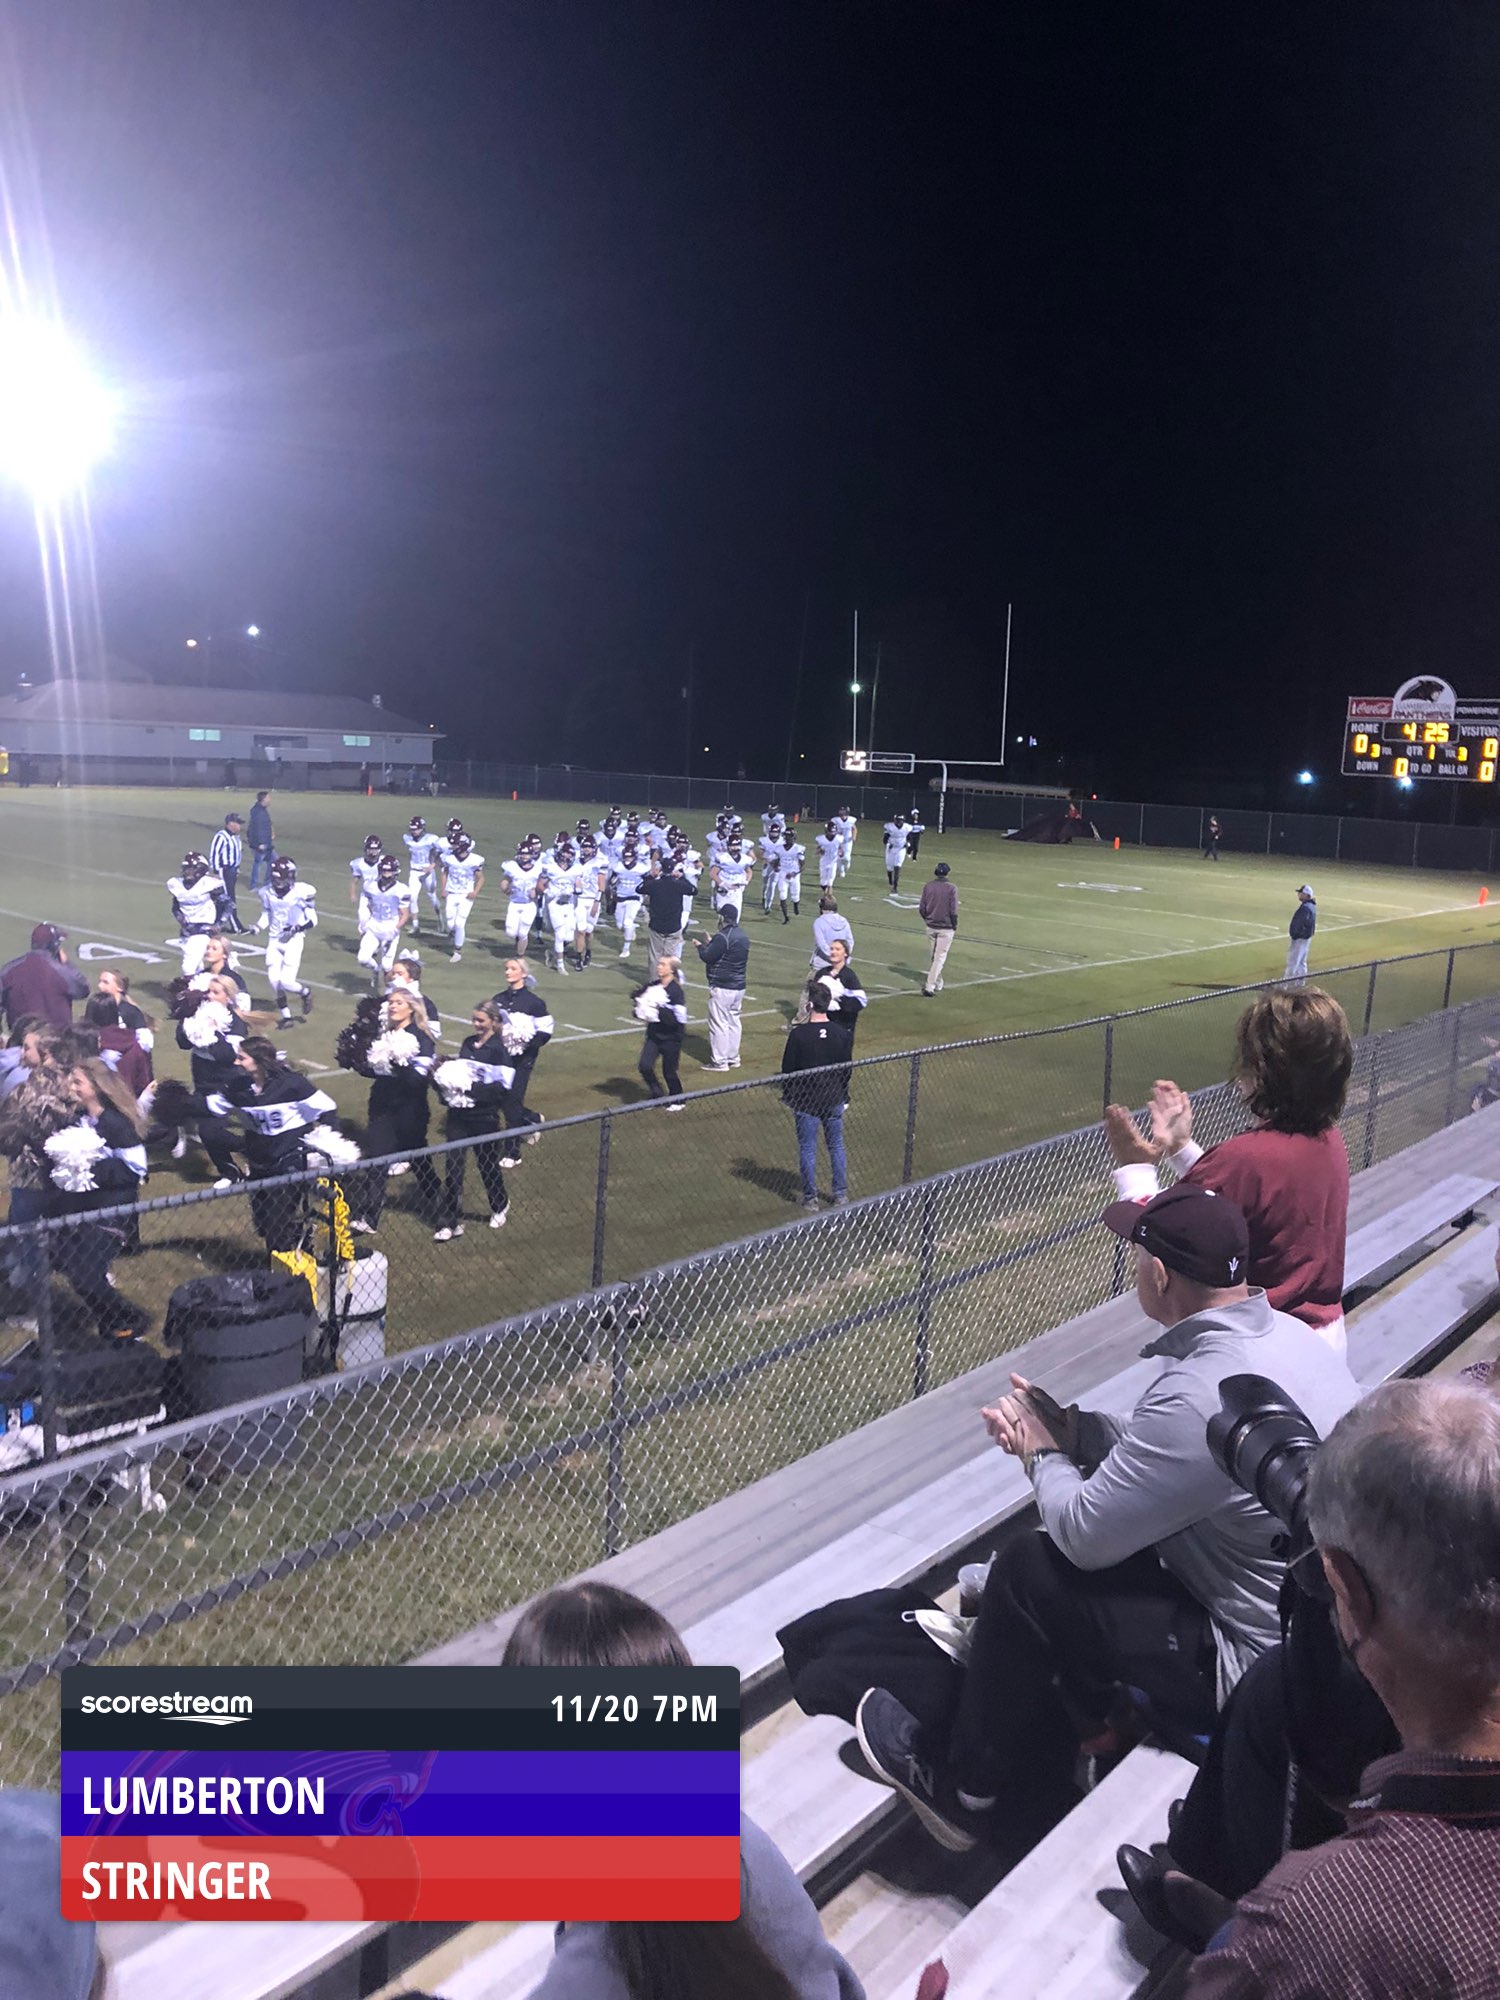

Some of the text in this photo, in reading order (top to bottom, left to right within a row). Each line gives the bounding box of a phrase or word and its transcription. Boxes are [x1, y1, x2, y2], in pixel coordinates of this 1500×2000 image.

[1351, 723, 1379, 733] HOME
[1461, 725, 1499, 737] VISITOR
[1354, 733, 1369, 754] 0
[1483, 737, 1499, 759] 0
[1370, 743, 1381, 758] 3
[1406, 745, 1424, 757] QTR
[1457, 746, 1468, 762] 3
[1356, 761, 1379, 771] DOWN
[1394, 757, 1409, 777] 0
[1410, 762, 1432, 774] TO GO
[1438, 763, 1469, 775] BALL ON
[1479, 760, 1495, 782] 0
[819, 1028, 828, 1039] 2
